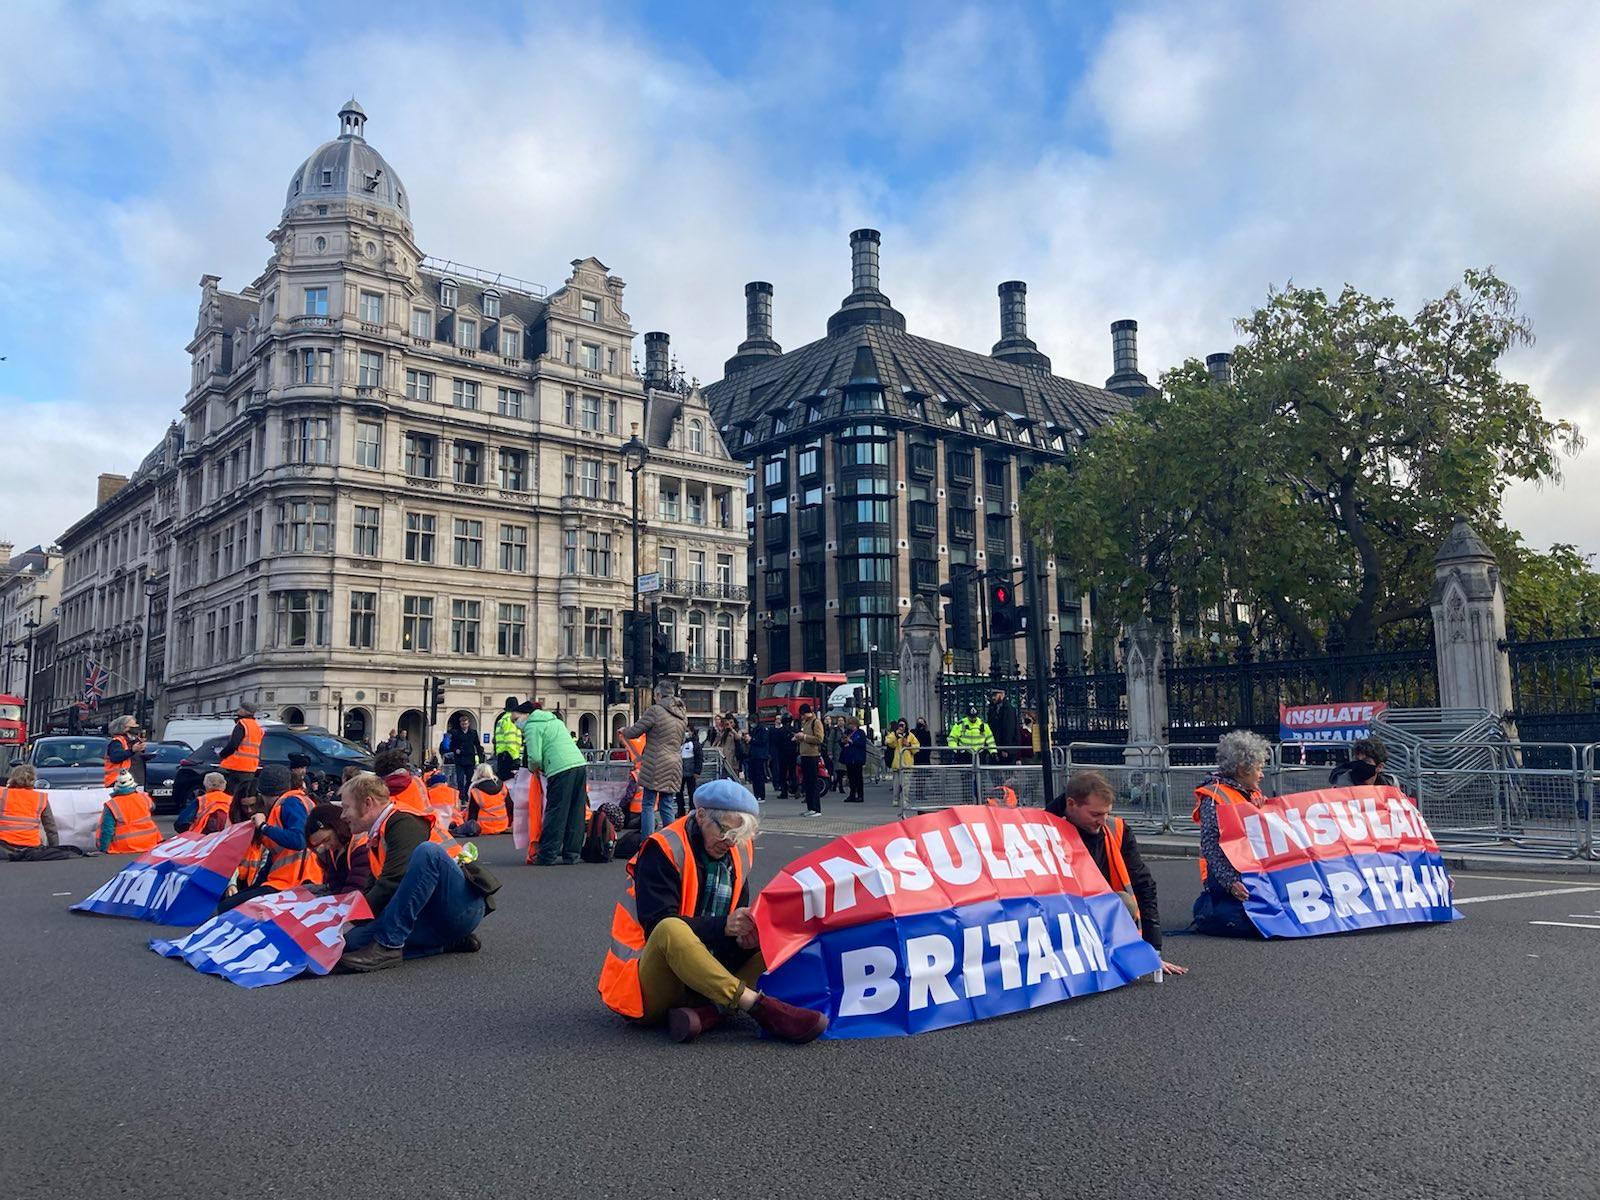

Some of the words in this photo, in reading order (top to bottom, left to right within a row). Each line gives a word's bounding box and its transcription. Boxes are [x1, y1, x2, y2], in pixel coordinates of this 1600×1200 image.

[1286, 706, 1373, 724] INSULATE
[792, 823, 1073, 922] INSULATE
[1286, 865, 1450, 924] BRITAIN
[838, 912, 1109, 1017] BRITAIN
